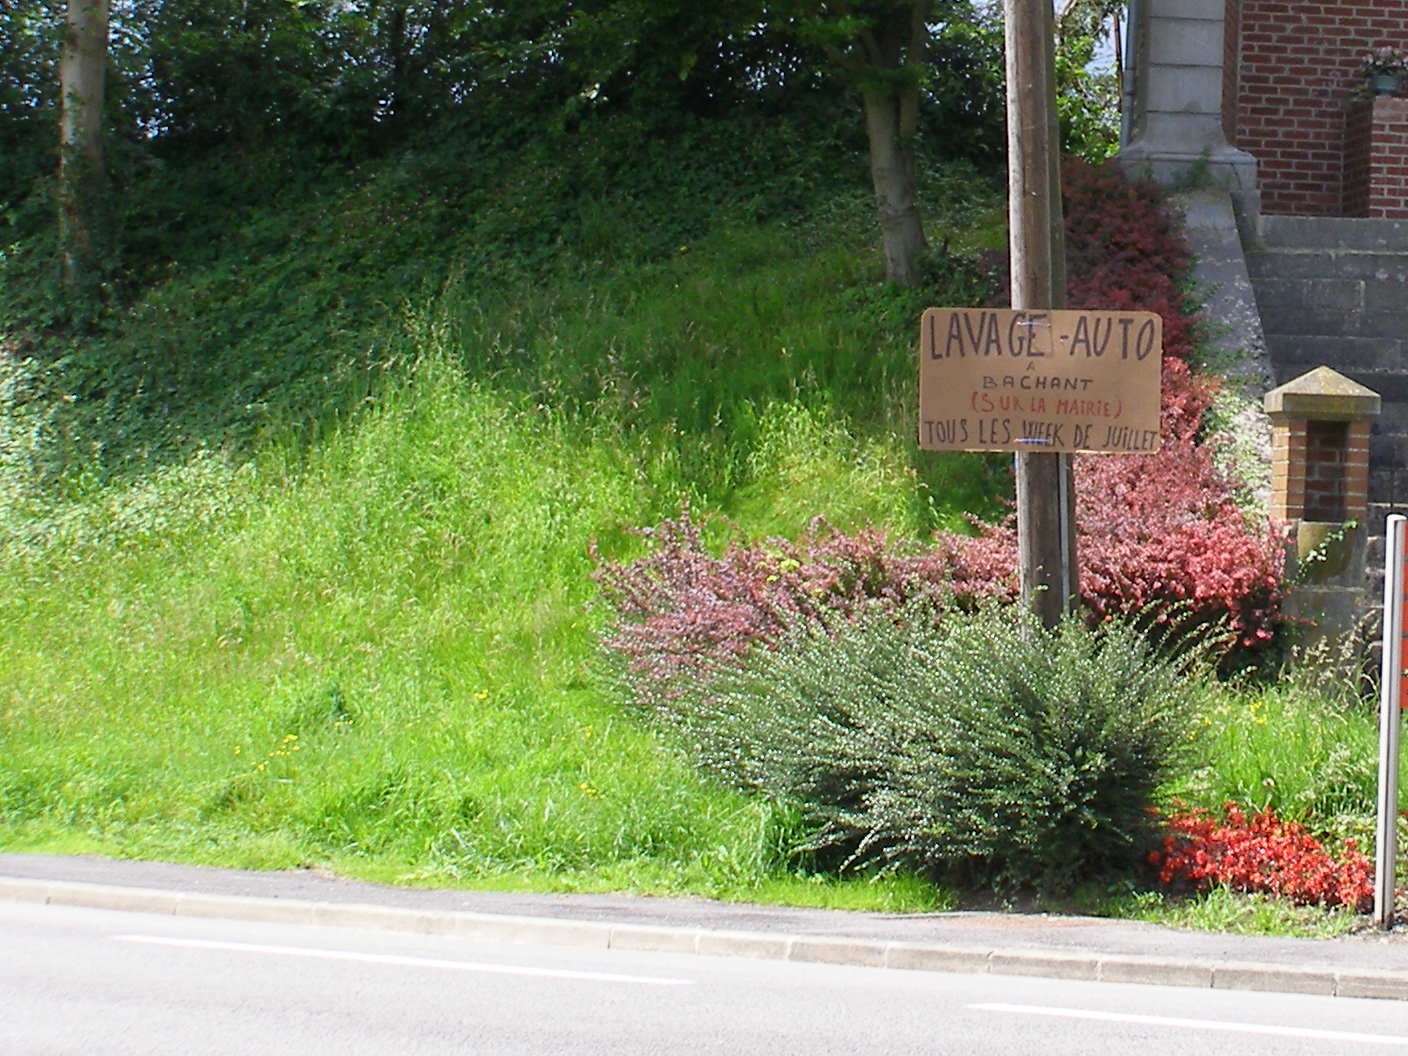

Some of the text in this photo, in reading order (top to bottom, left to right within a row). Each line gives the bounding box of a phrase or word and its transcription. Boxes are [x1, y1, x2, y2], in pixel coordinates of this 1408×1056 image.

[929, 311, 1048, 360] LAVAGE
[983, 375, 1093, 391] BACHANT
[971, 391, 1023, 414] (SUR
[1031, 397, 1046, 413] LA
[924, 419, 968, 444] TOUS
[979, 418, 1010, 444] LES
[1022, 420, 1065, 447] WEEK
[1073, 424, 1094, 449] DE
